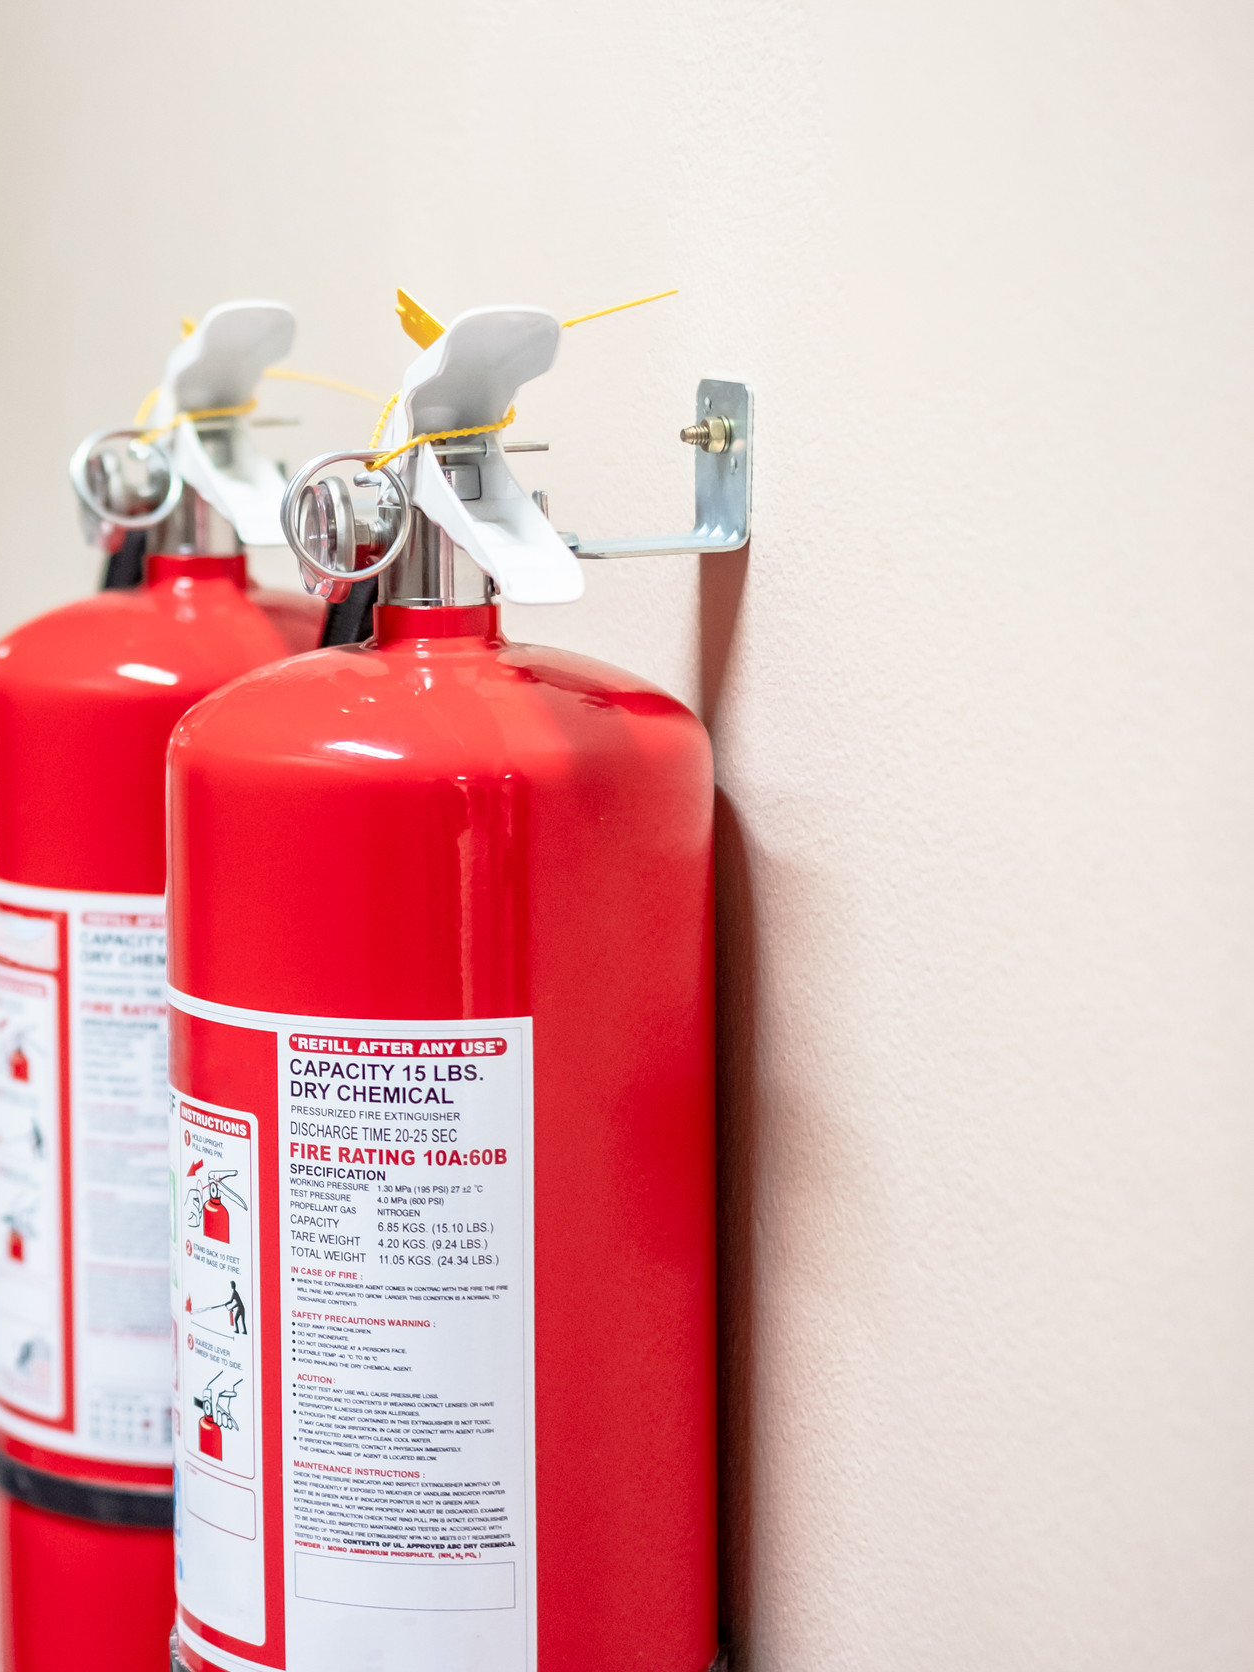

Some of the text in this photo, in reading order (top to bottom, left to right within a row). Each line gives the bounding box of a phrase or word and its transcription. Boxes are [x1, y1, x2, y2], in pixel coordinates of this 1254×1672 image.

[292, 1036, 503, 1055] "REFILL AFTER ANY USE"
[290, 1058, 483, 1082] CAPACITY 15 LBS.
[290, 1080, 454, 1104] DRY CHEMICAL
[291, 1104, 460, 1121] PRESSURIZED FIRE EXTINGUISHER
[181, 1105, 247, 1136] INSTRUCTIONS
[192, 1134, 202, 1142] HOLD
[290, 1121, 457, 1143] DISCHARGE TIME 20-25 SEC
[290, 1142, 507, 1166] FIRE RATING 10A:60B
[290, 1163, 385, 1181] SPECIFICATION
[289, 1177, 369, 1191] WORKING PRESSURE
[377, 1185, 393, 1193] 1.30
[395, 1185, 412, 1193] MPa
[413, 1185, 430, 1195] (195
[432, 1185, 449, 1194] PSI)
[450, 1185, 460, 1193] 27
[290, 1188, 351, 1202] TEST PRESSURE
[377, 1196, 444, 1206] 4.0 MPa (600 PSI)
[290, 1200, 356, 1214] PROPELLANT GAS
[377, 1208, 420, 1217] NITROGEN
[290, 1214, 339, 1228] CAPACITY
[377, 1221, 493, 1235] 6.85 KGS. (15.10 LBS.)
[290, 1229, 360, 1246] TARE WEIGHT
[377, 1238, 488, 1251] 4.20 KGS. (9.24 LBS.)
[206, 1248, 218, 1258] BACK
[226, 1255, 240, 1264] FEET
[290, 1245, 366, 1262] TOTAL WEIGHT
[379, 1254, 499, 1267] 11.05 KGS. (24.34 LBS.)
[206, 1258, 218, 1268] BASE
[300, 1267, 322, 1276] CASE
[338, 1271, 357, 1279] FIRE
[291, 1310, 322, 1321] SAFETY
[324, 1314, 386, 1326] PRECAUTIONS
[387, 1319, 430, 1327] WARNING
[296, 1373, 336, 1384] ACUTION:
[293, 1459, 352, 1474] MAINTENANCE
[354, 1468, 420, 1478] INSTRUCTIONS
[294, 1540, 320, 1549] POWDER
[327, 1545, 347, 1553] MONO
[349, 1548, 388, 1556] AMMONIUM
[342, 1538, 380, 1547] CONTENTS
[479, 1541, 516, 1549] CHEMICAL
